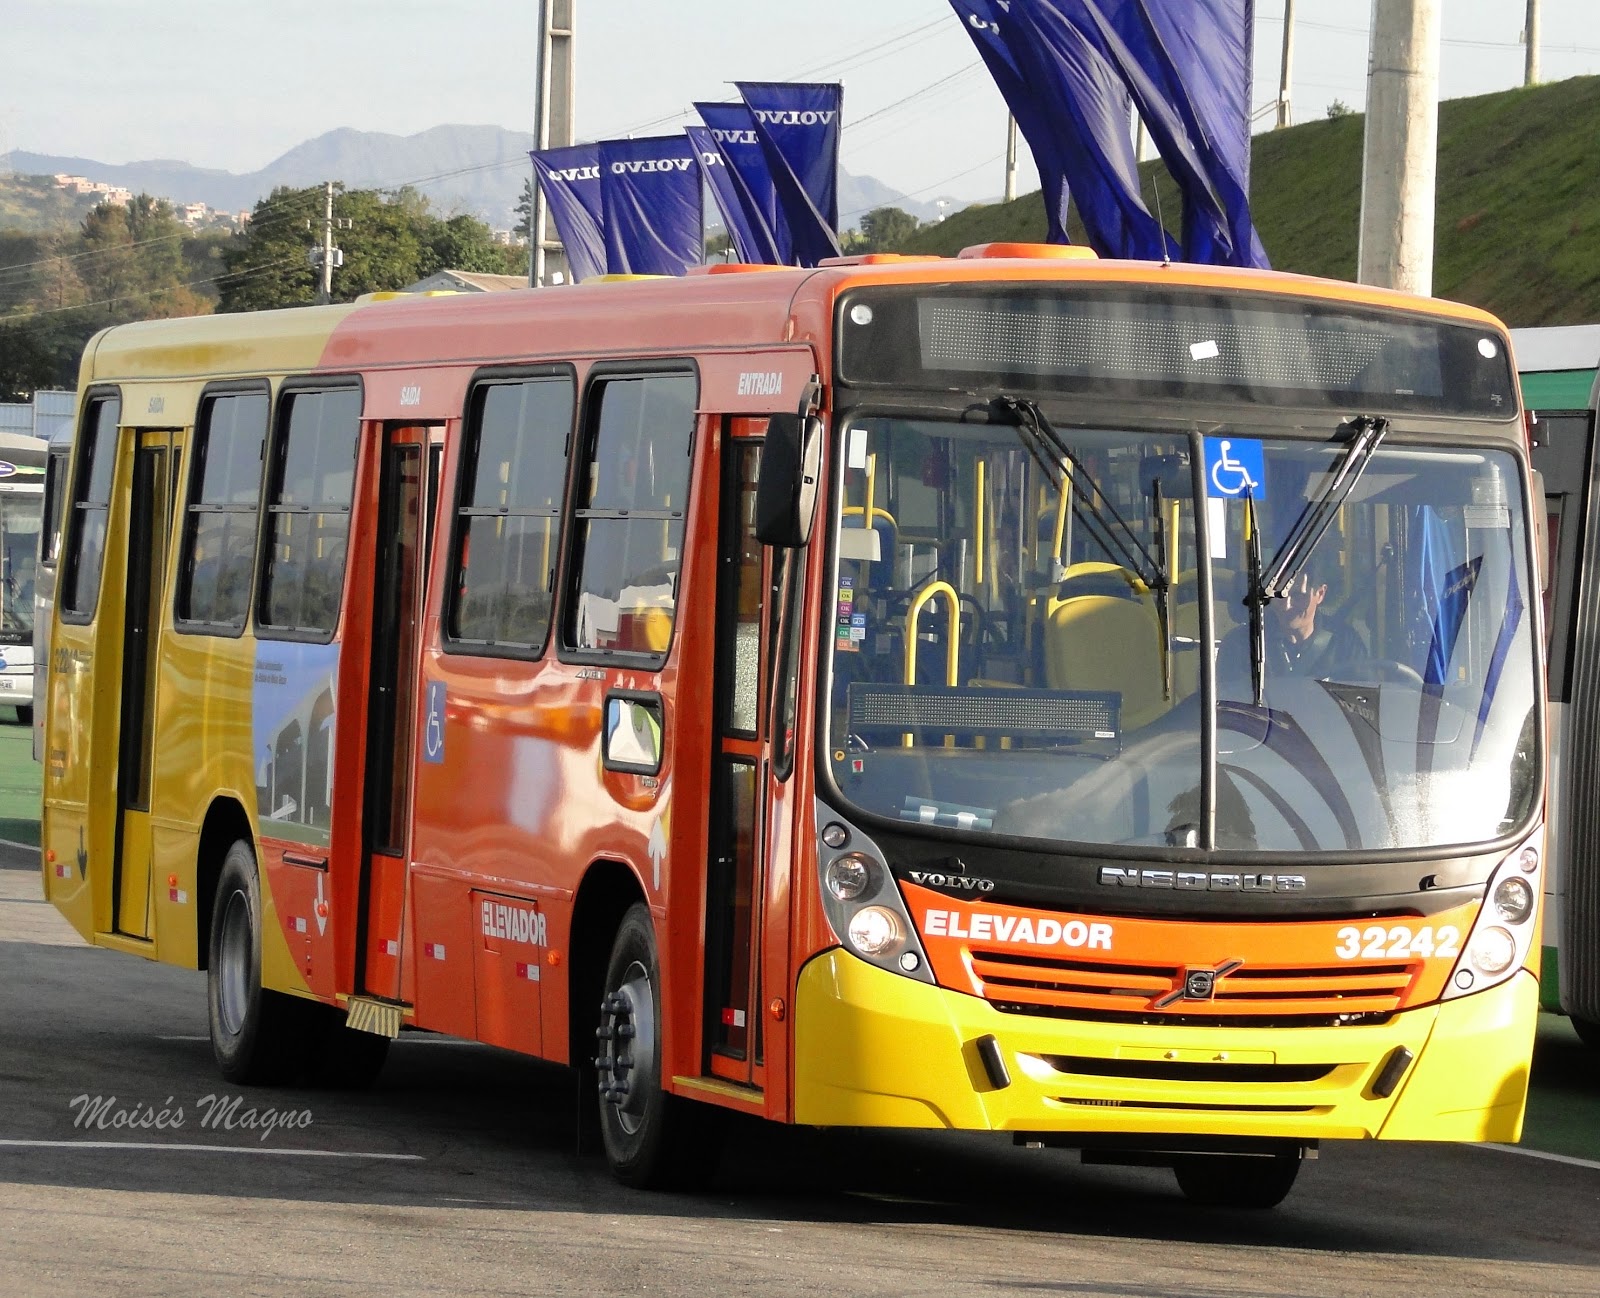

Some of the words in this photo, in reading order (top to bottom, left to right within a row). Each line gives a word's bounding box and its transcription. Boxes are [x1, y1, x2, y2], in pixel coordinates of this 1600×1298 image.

[738, 372, 782, 395] ENTRADA
[909, 871, 995, 892] VOLVO
[1101, 867, 1306, 892] NEOBUS
[481, 900, 548, 947] ELEVADOR
[924, 909, 1113, 950] ELEVADOR
[1335, 925, 1460, 959] 32242
